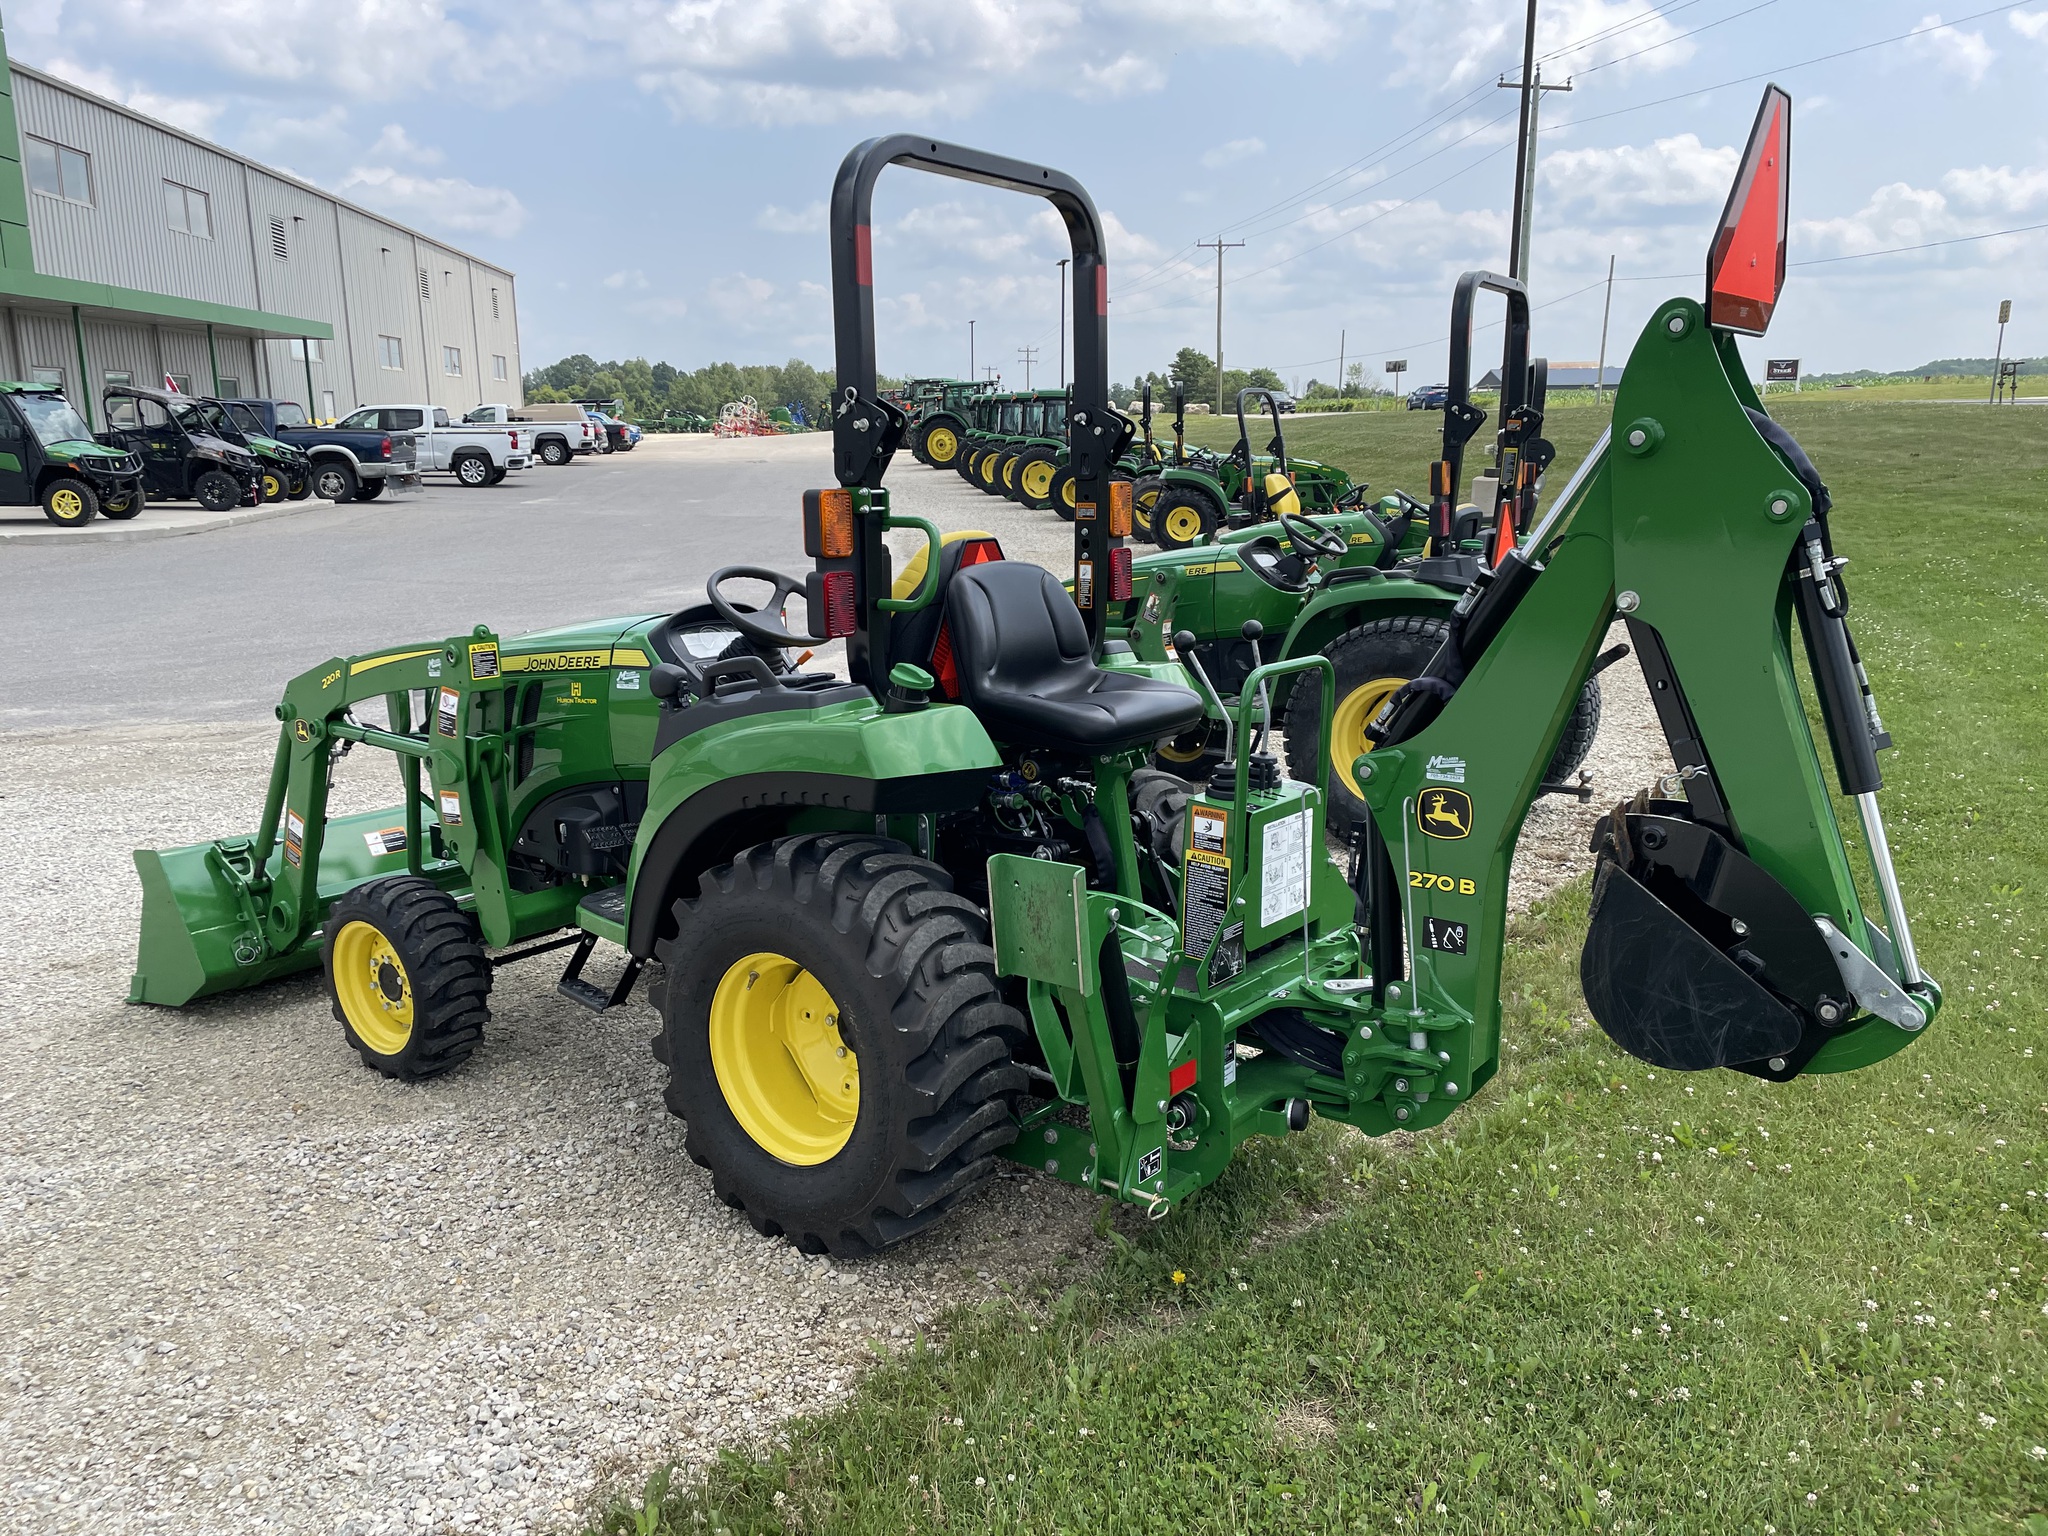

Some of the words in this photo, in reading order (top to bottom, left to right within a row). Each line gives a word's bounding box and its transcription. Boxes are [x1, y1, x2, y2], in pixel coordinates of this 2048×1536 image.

[523, 658, 556, 672] JOHN
[558, 655, 601, 669] DEERE
[574, 697, 598, 705] TRACTOR
[1200, 809, 1225, 820] WARNING
[1197, 853, 1226, 866] CAUTION
[1409, 872, 1455, 893] 270
[1459, 878, 1476, 895] B
